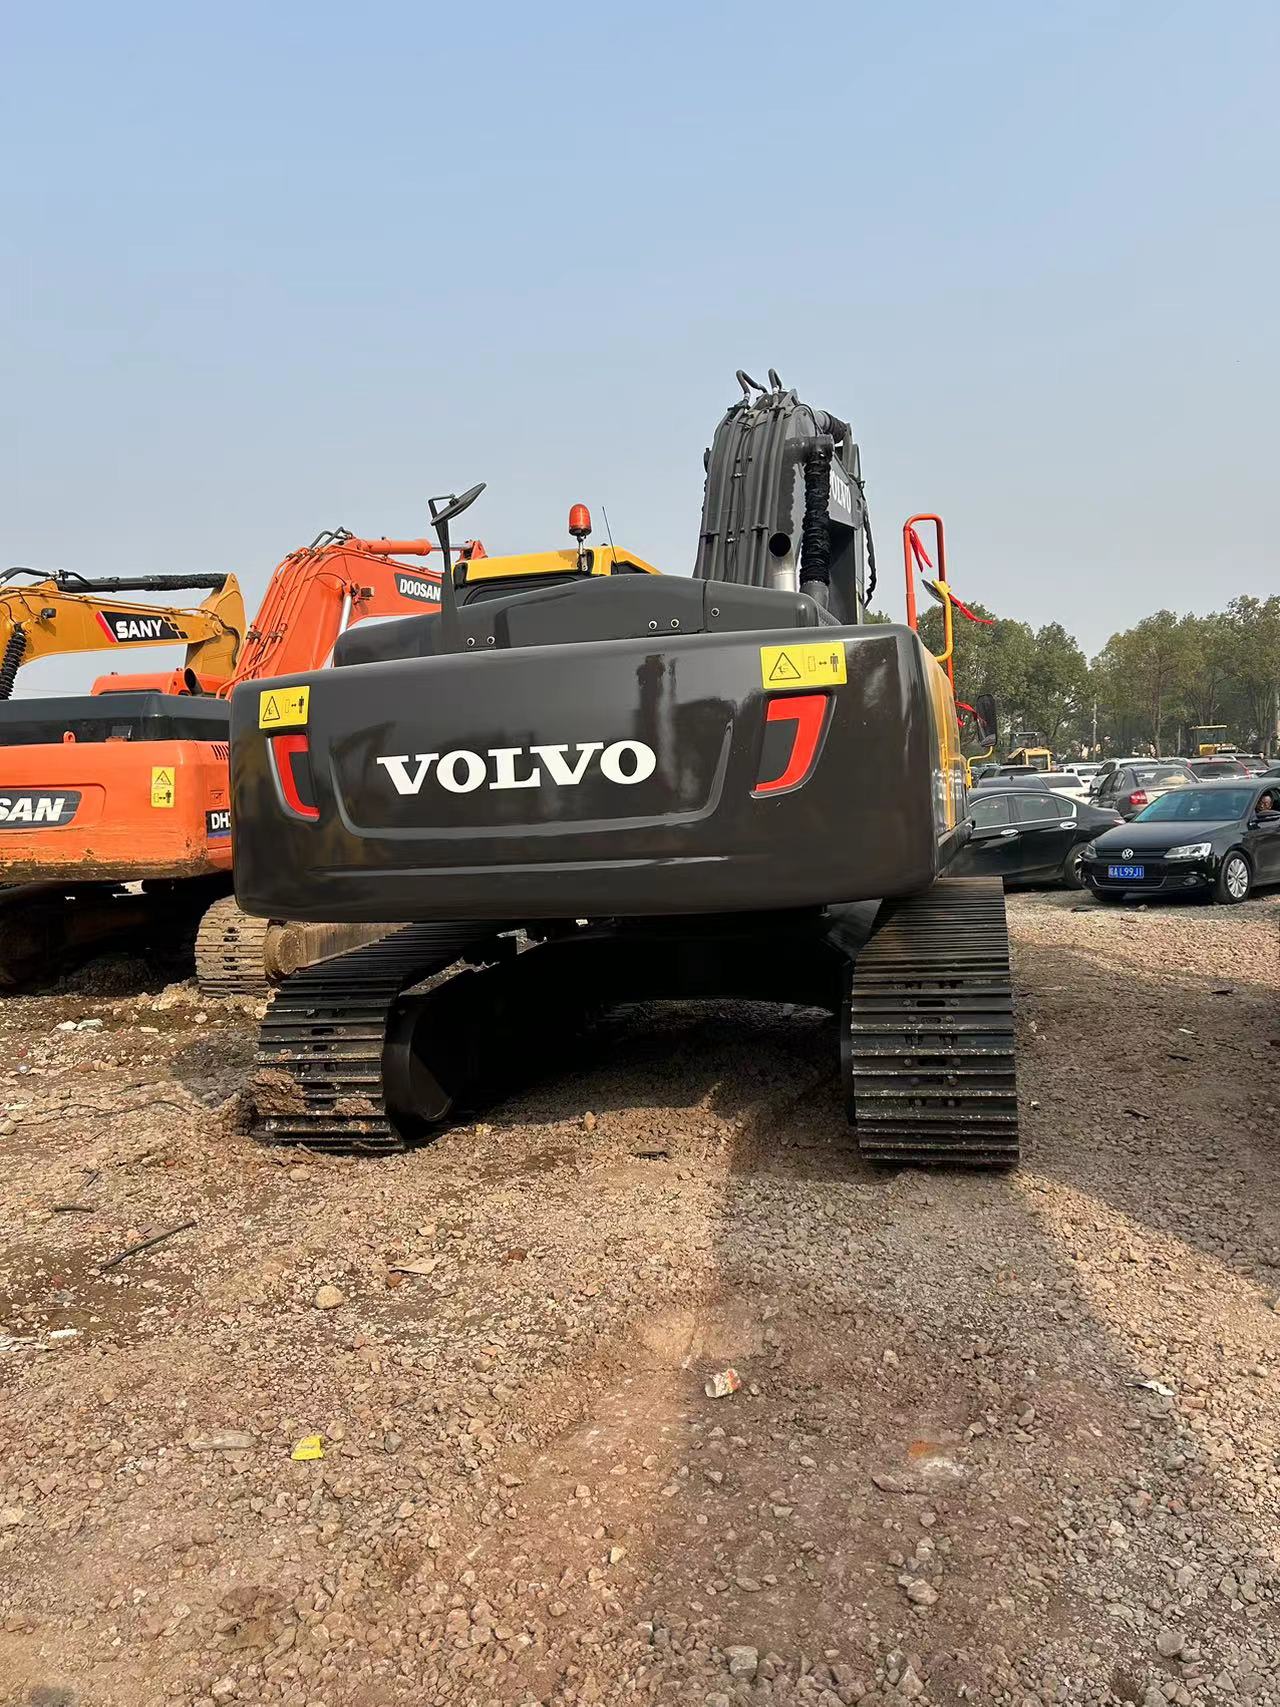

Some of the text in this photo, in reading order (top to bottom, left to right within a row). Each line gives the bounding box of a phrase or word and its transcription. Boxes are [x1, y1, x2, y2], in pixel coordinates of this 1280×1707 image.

[400, 578, 441, 601] DOOSAN
[116, 620, 162, 639] SANY
[377, 740, 657, 795] VOLVO
[211, 811, 231, 830] DH
